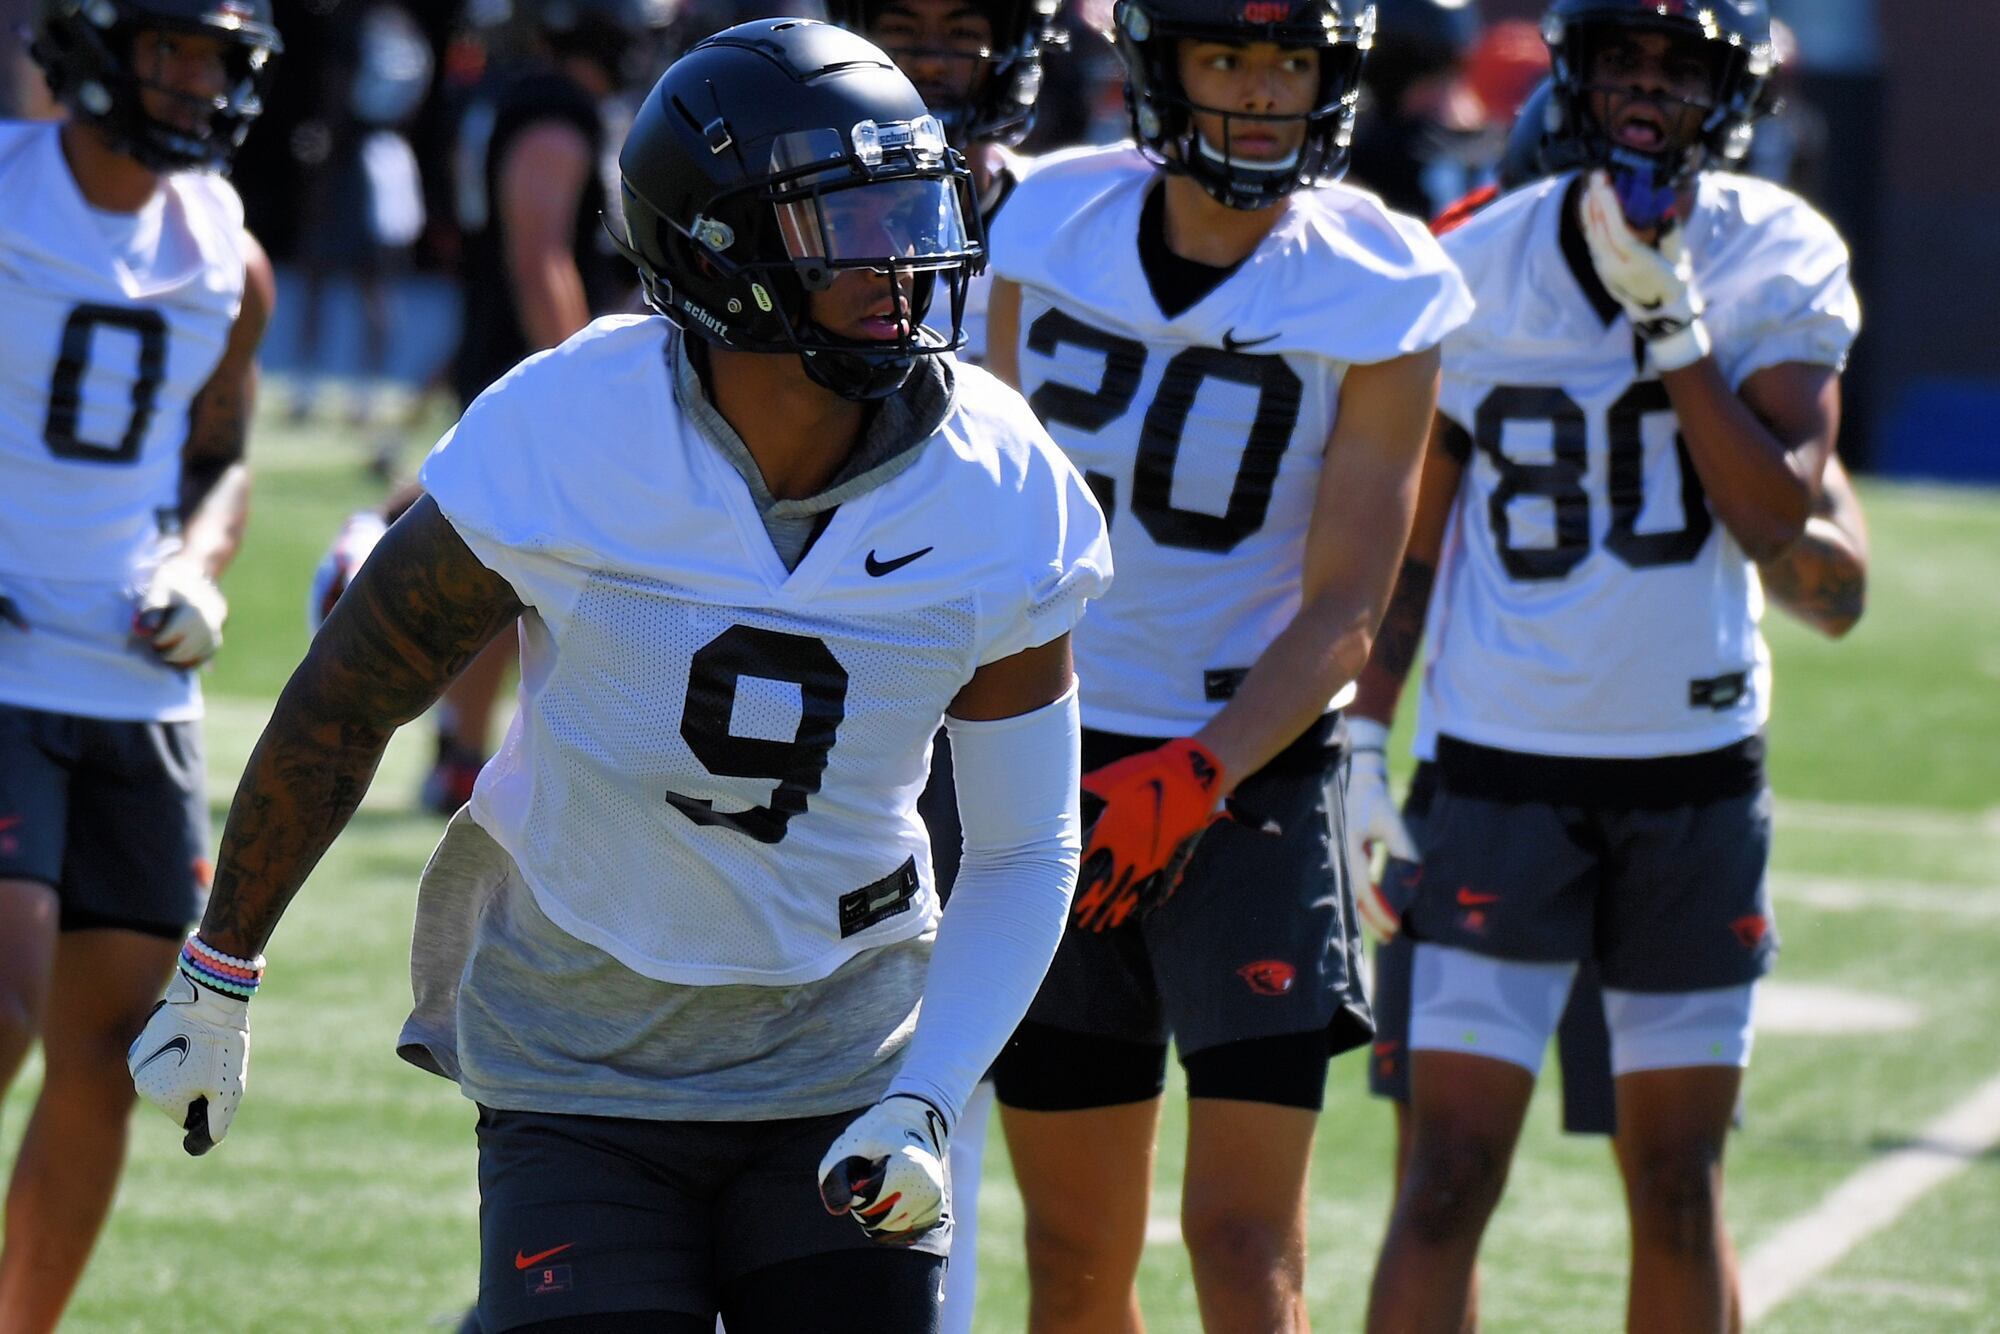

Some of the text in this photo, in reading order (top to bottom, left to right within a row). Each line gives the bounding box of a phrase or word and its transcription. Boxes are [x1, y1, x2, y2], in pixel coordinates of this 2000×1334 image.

[46, 304, 168, 463] 0
[683, 300, 728, 337] schutt
[1027, 306, 1304, 555] 20
[1475, 379, 1713, 583] 80
[666, 624, 849, 844] 9
[906, 872, 914, 886] L
[543, 1269, 554, 1285] 9
